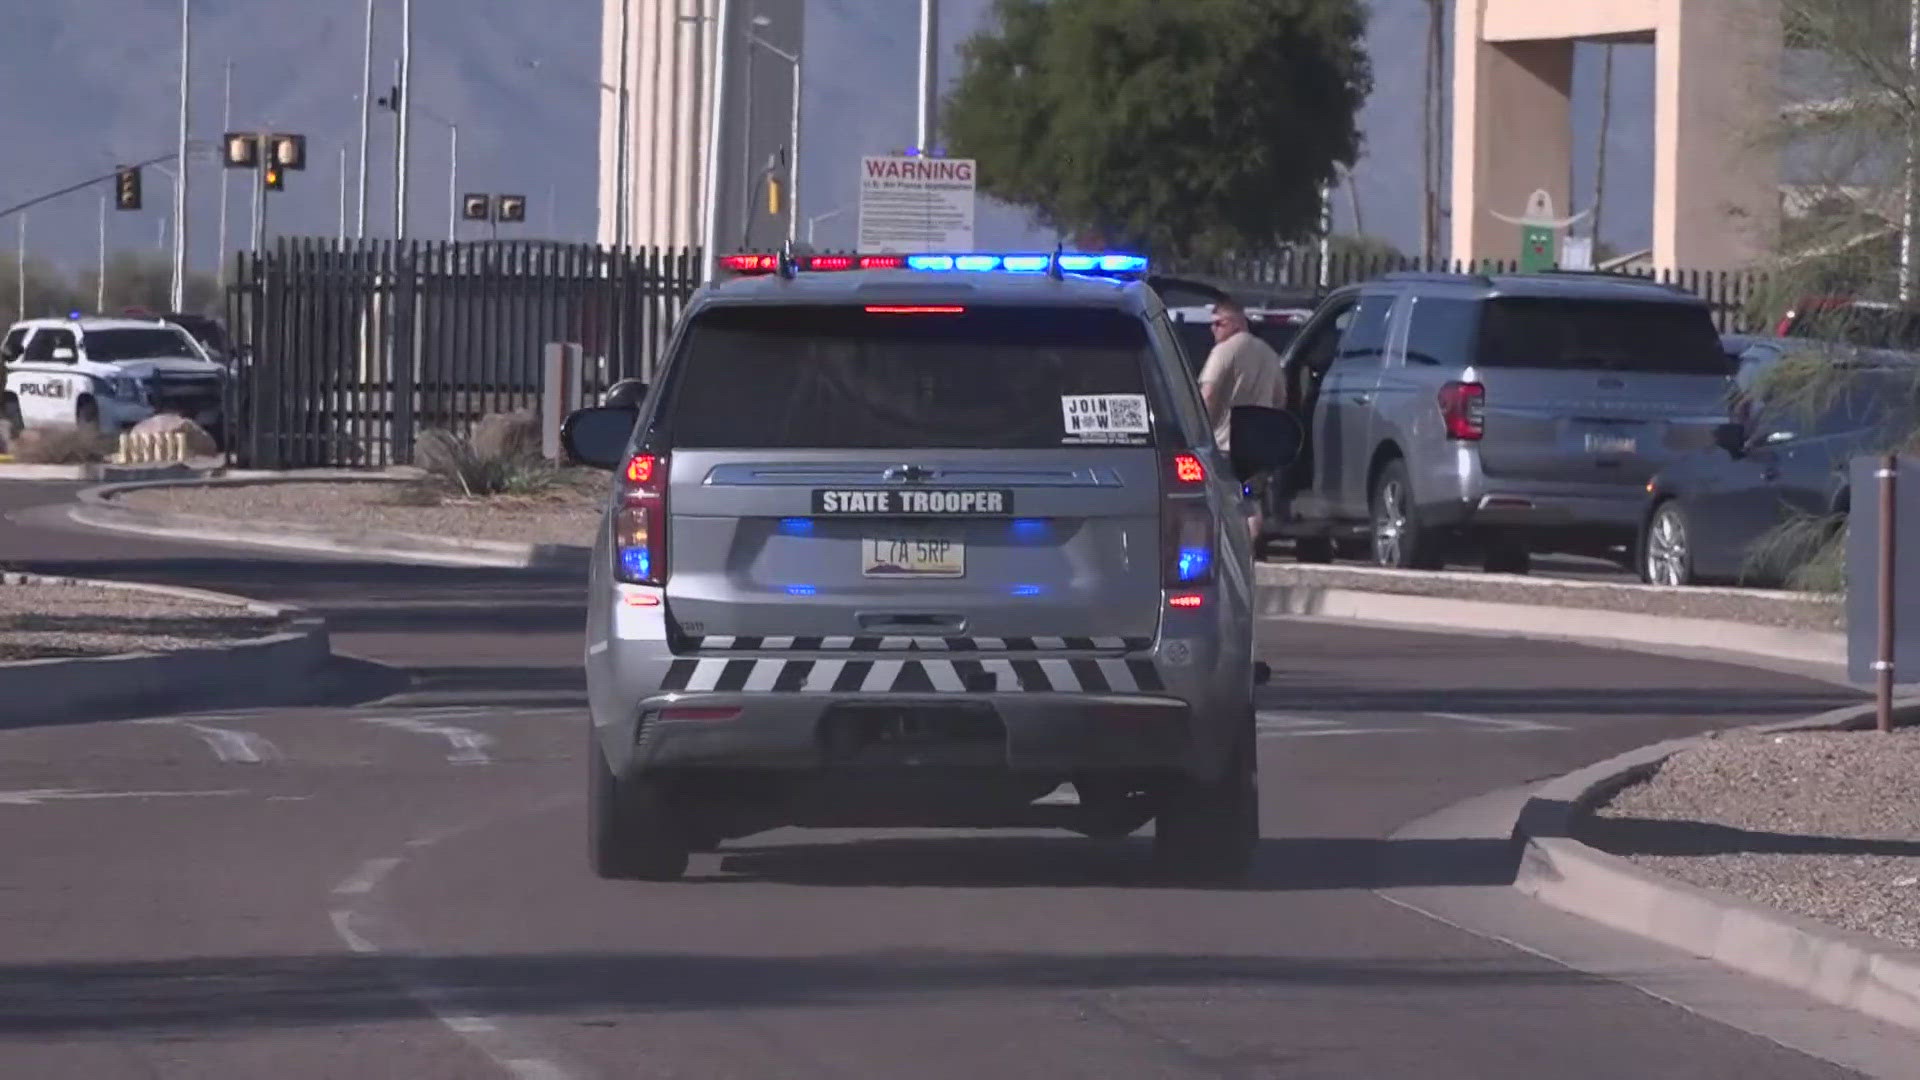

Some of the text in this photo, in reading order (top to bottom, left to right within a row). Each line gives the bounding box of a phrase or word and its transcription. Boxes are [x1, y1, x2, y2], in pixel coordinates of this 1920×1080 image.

[866, 160, 972, 180] WARNING
[20, 382, 64, 398] POLICE
[1069, 398, 1107, 413] JOIN
[823, 491, 1003, 513] STATE TROOPER
[874, 537, 909, 563] L7A
